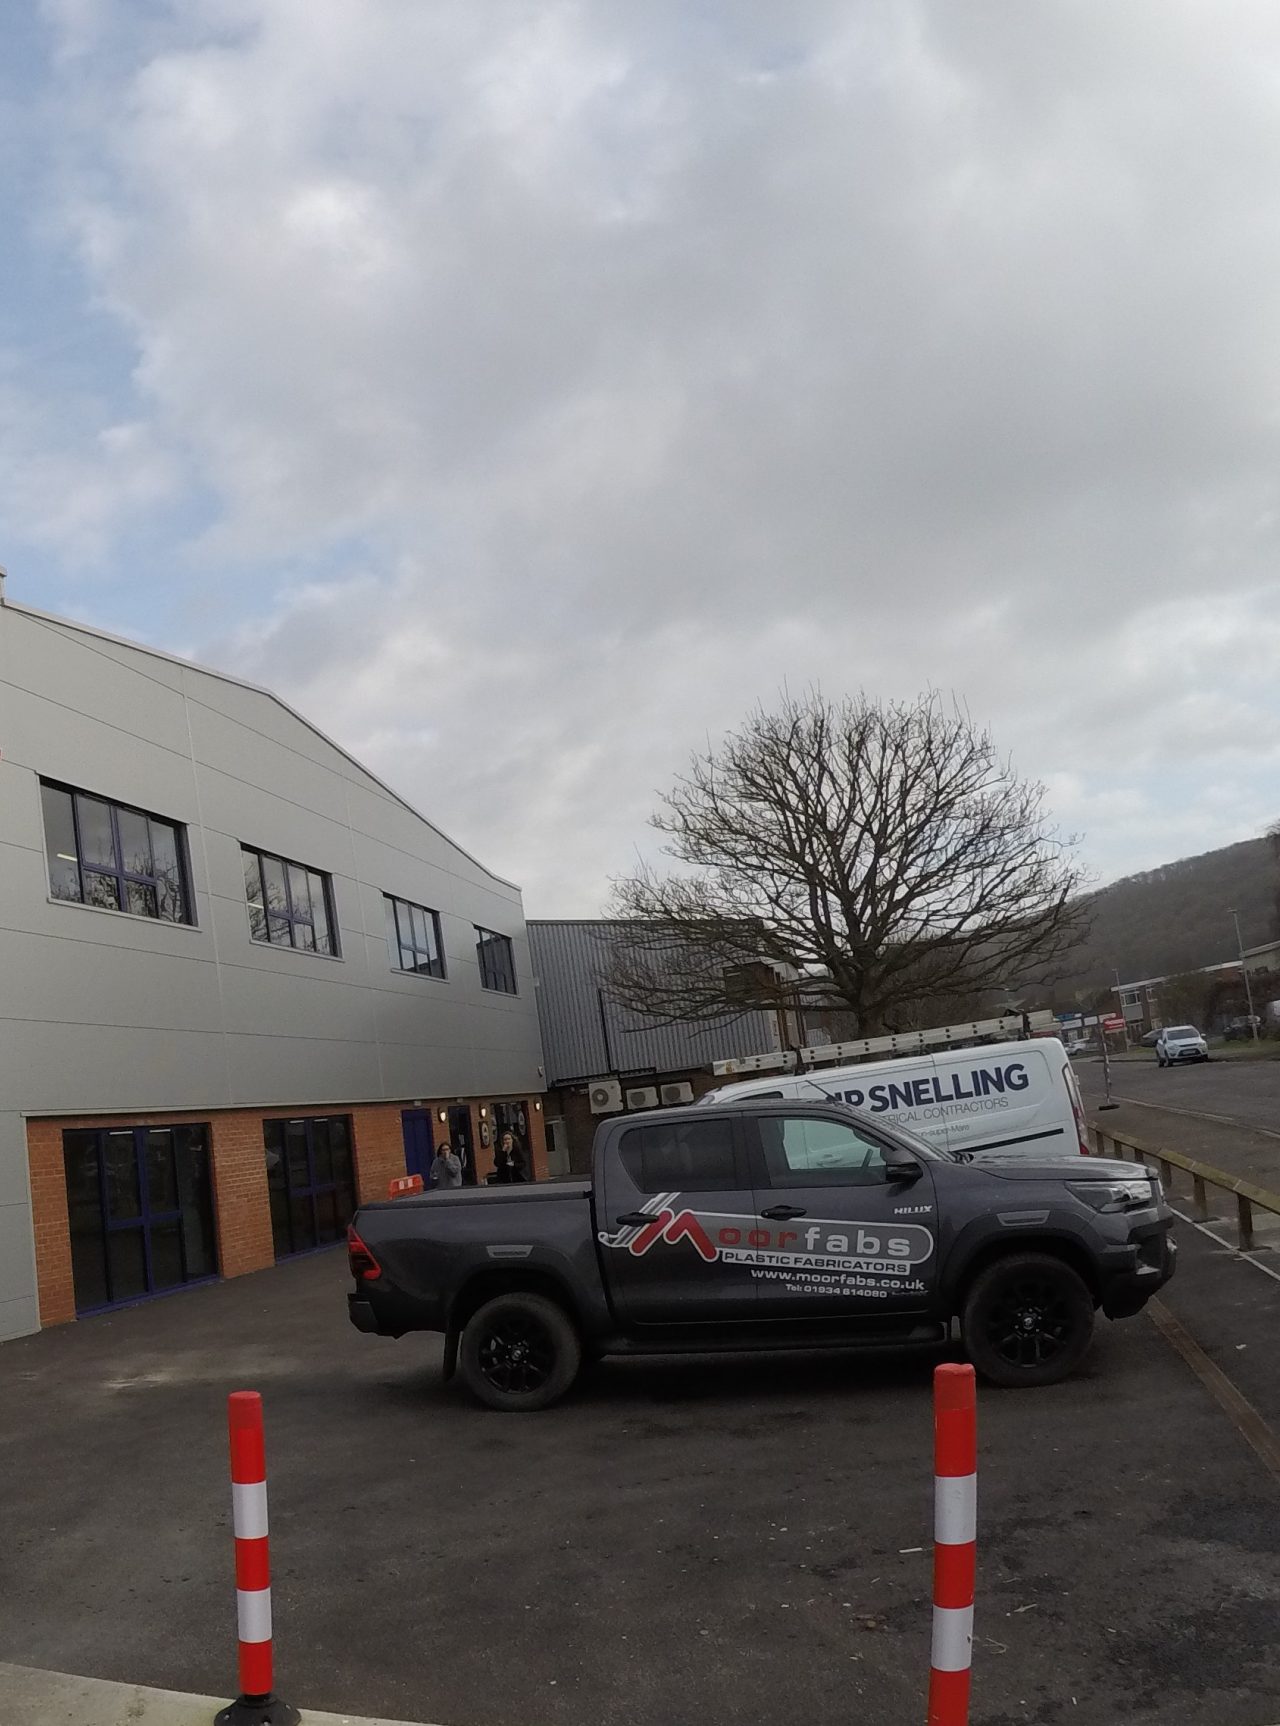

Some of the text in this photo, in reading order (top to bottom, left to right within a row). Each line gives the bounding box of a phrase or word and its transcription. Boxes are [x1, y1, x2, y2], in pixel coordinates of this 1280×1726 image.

[868, 1063, 1030, 1113] SNELLING
[923, 1096, 1009, 1120] CONTRACTORS
[893, 1204, 933, 1215] HILUX
[723, 1252, 908, 1274] PLASTIC FABRICATORS
[750, 1269, 926, 1291] www.moorfabs.co.uk
[785, 1283, 803, 1293] Tel:
[803, 1285, 841, 1295] 01934
